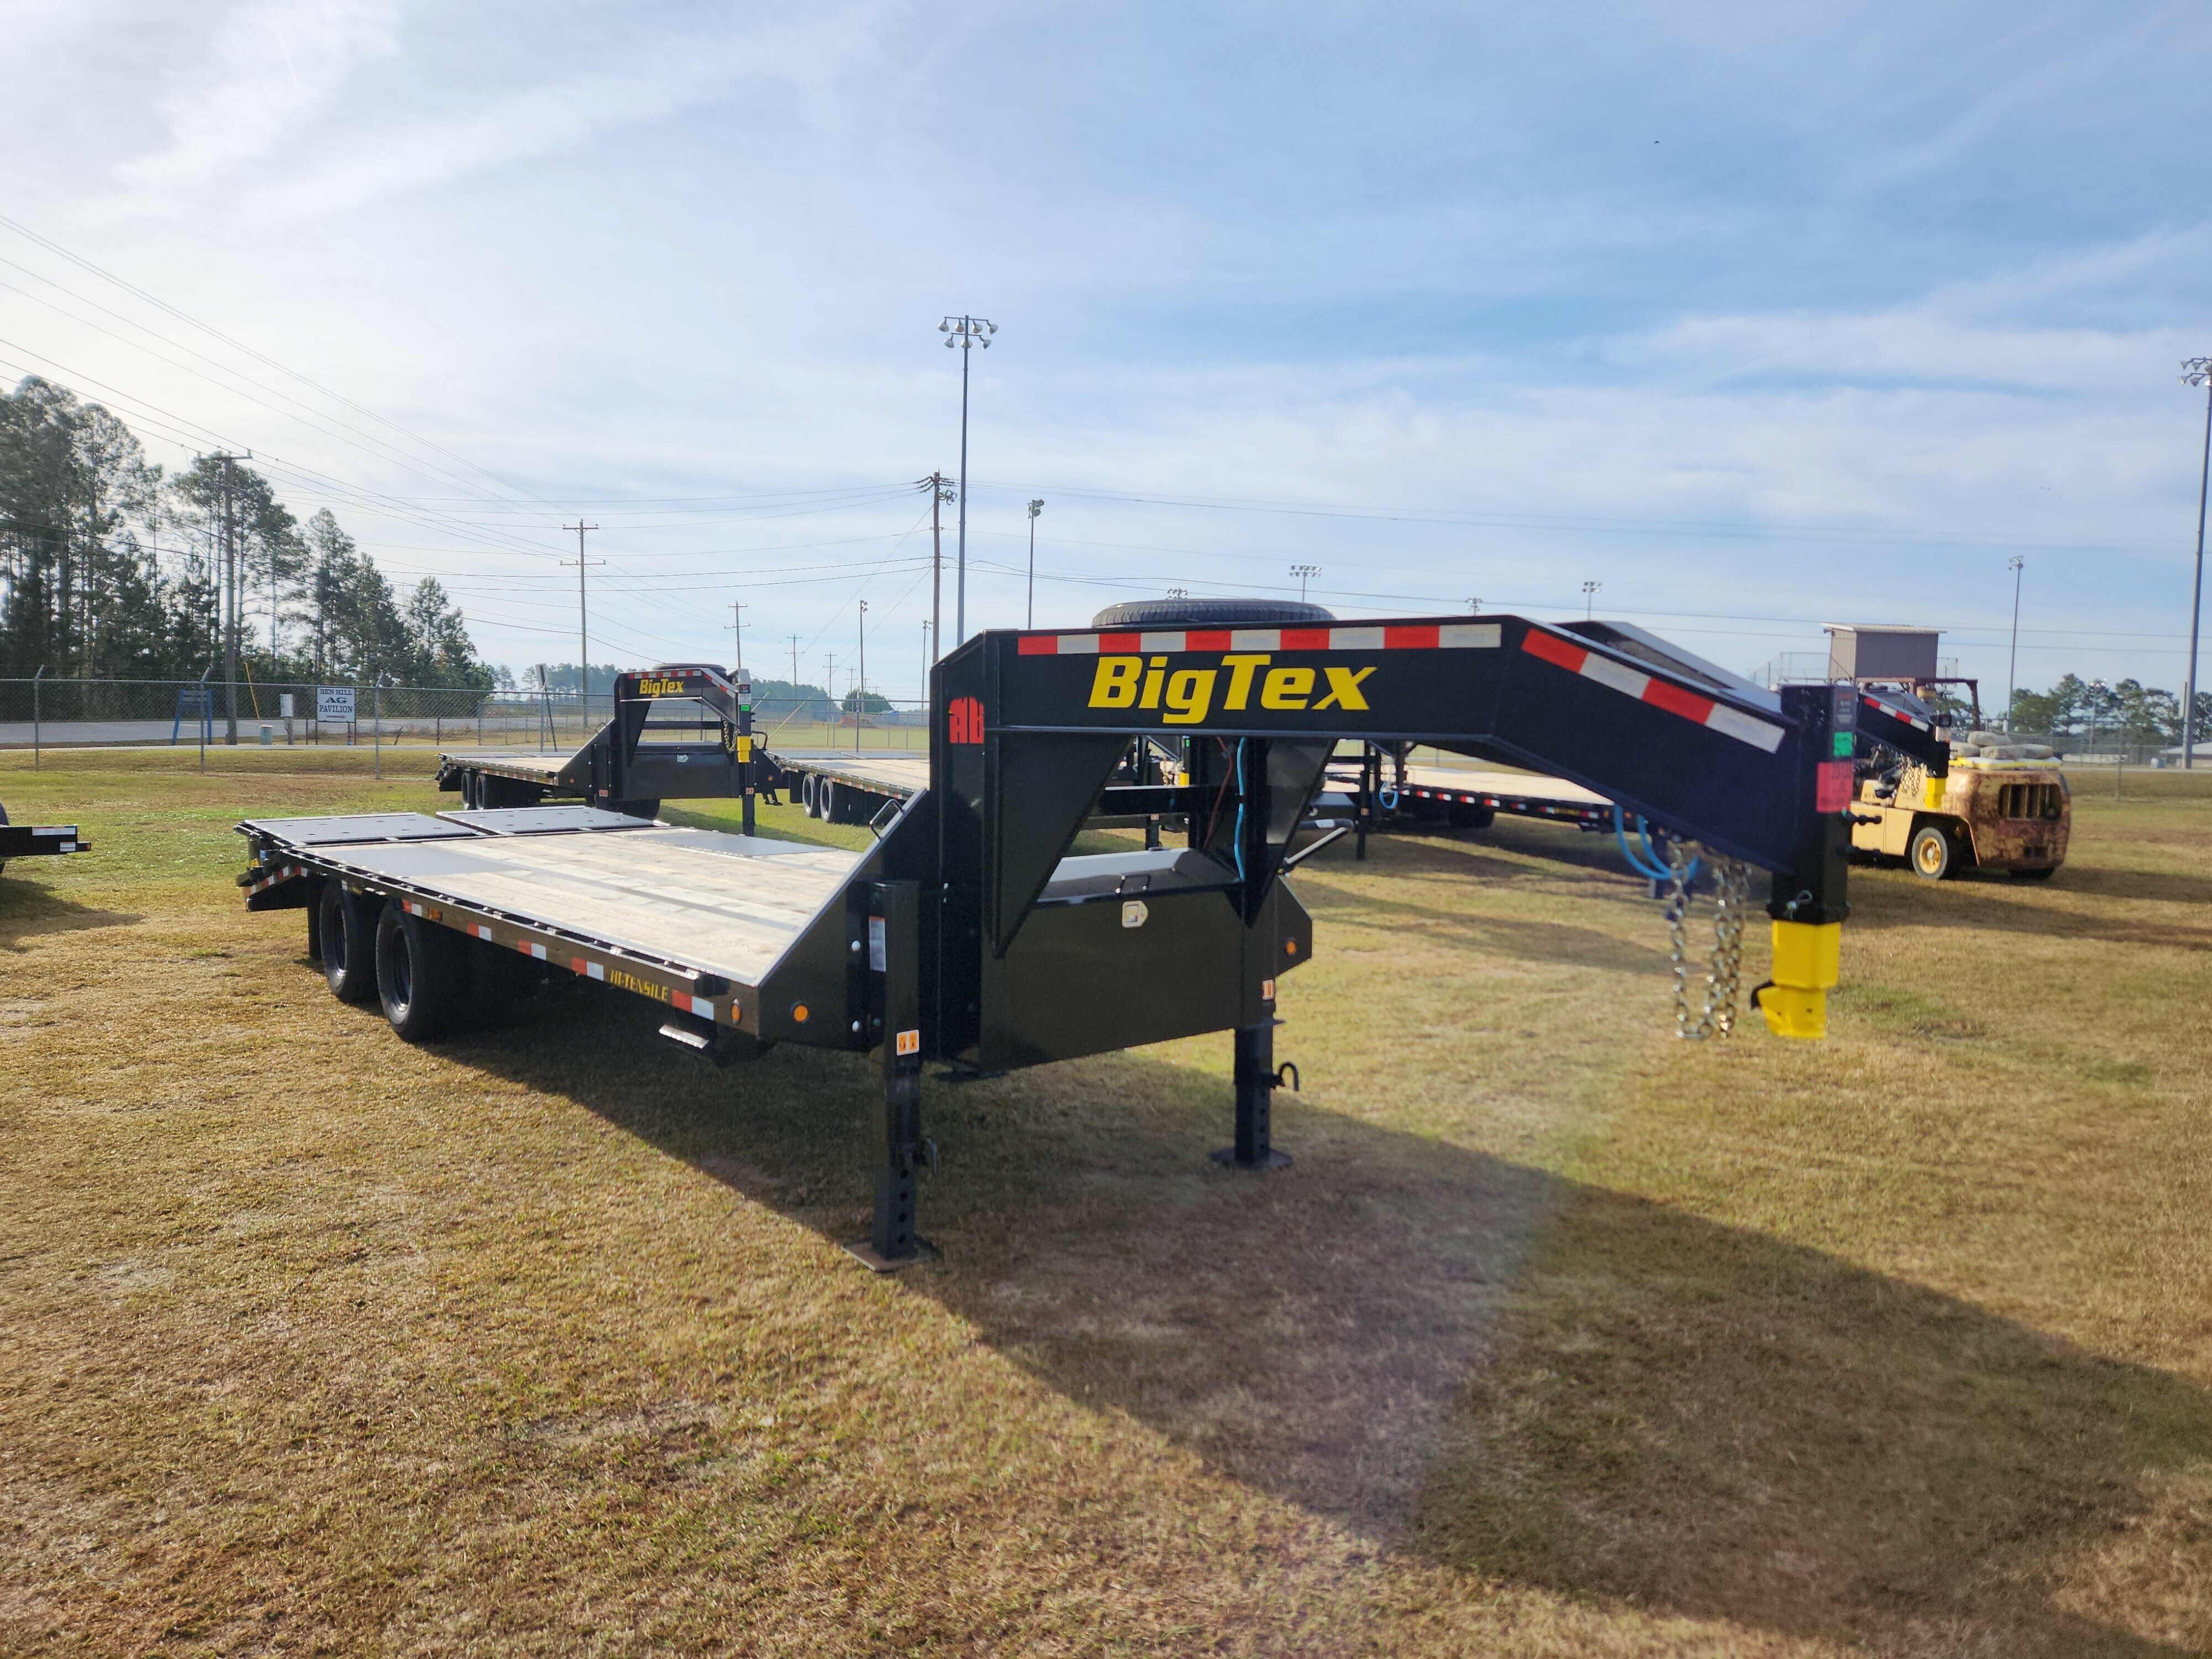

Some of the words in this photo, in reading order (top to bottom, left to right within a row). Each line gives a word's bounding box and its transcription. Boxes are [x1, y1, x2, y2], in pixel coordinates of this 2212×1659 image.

[639, 679, 684, 698] BigTex
[1088, 655, 1377, 724] BigTex
[610, 969, 668, 1001] HI-TENSILE
